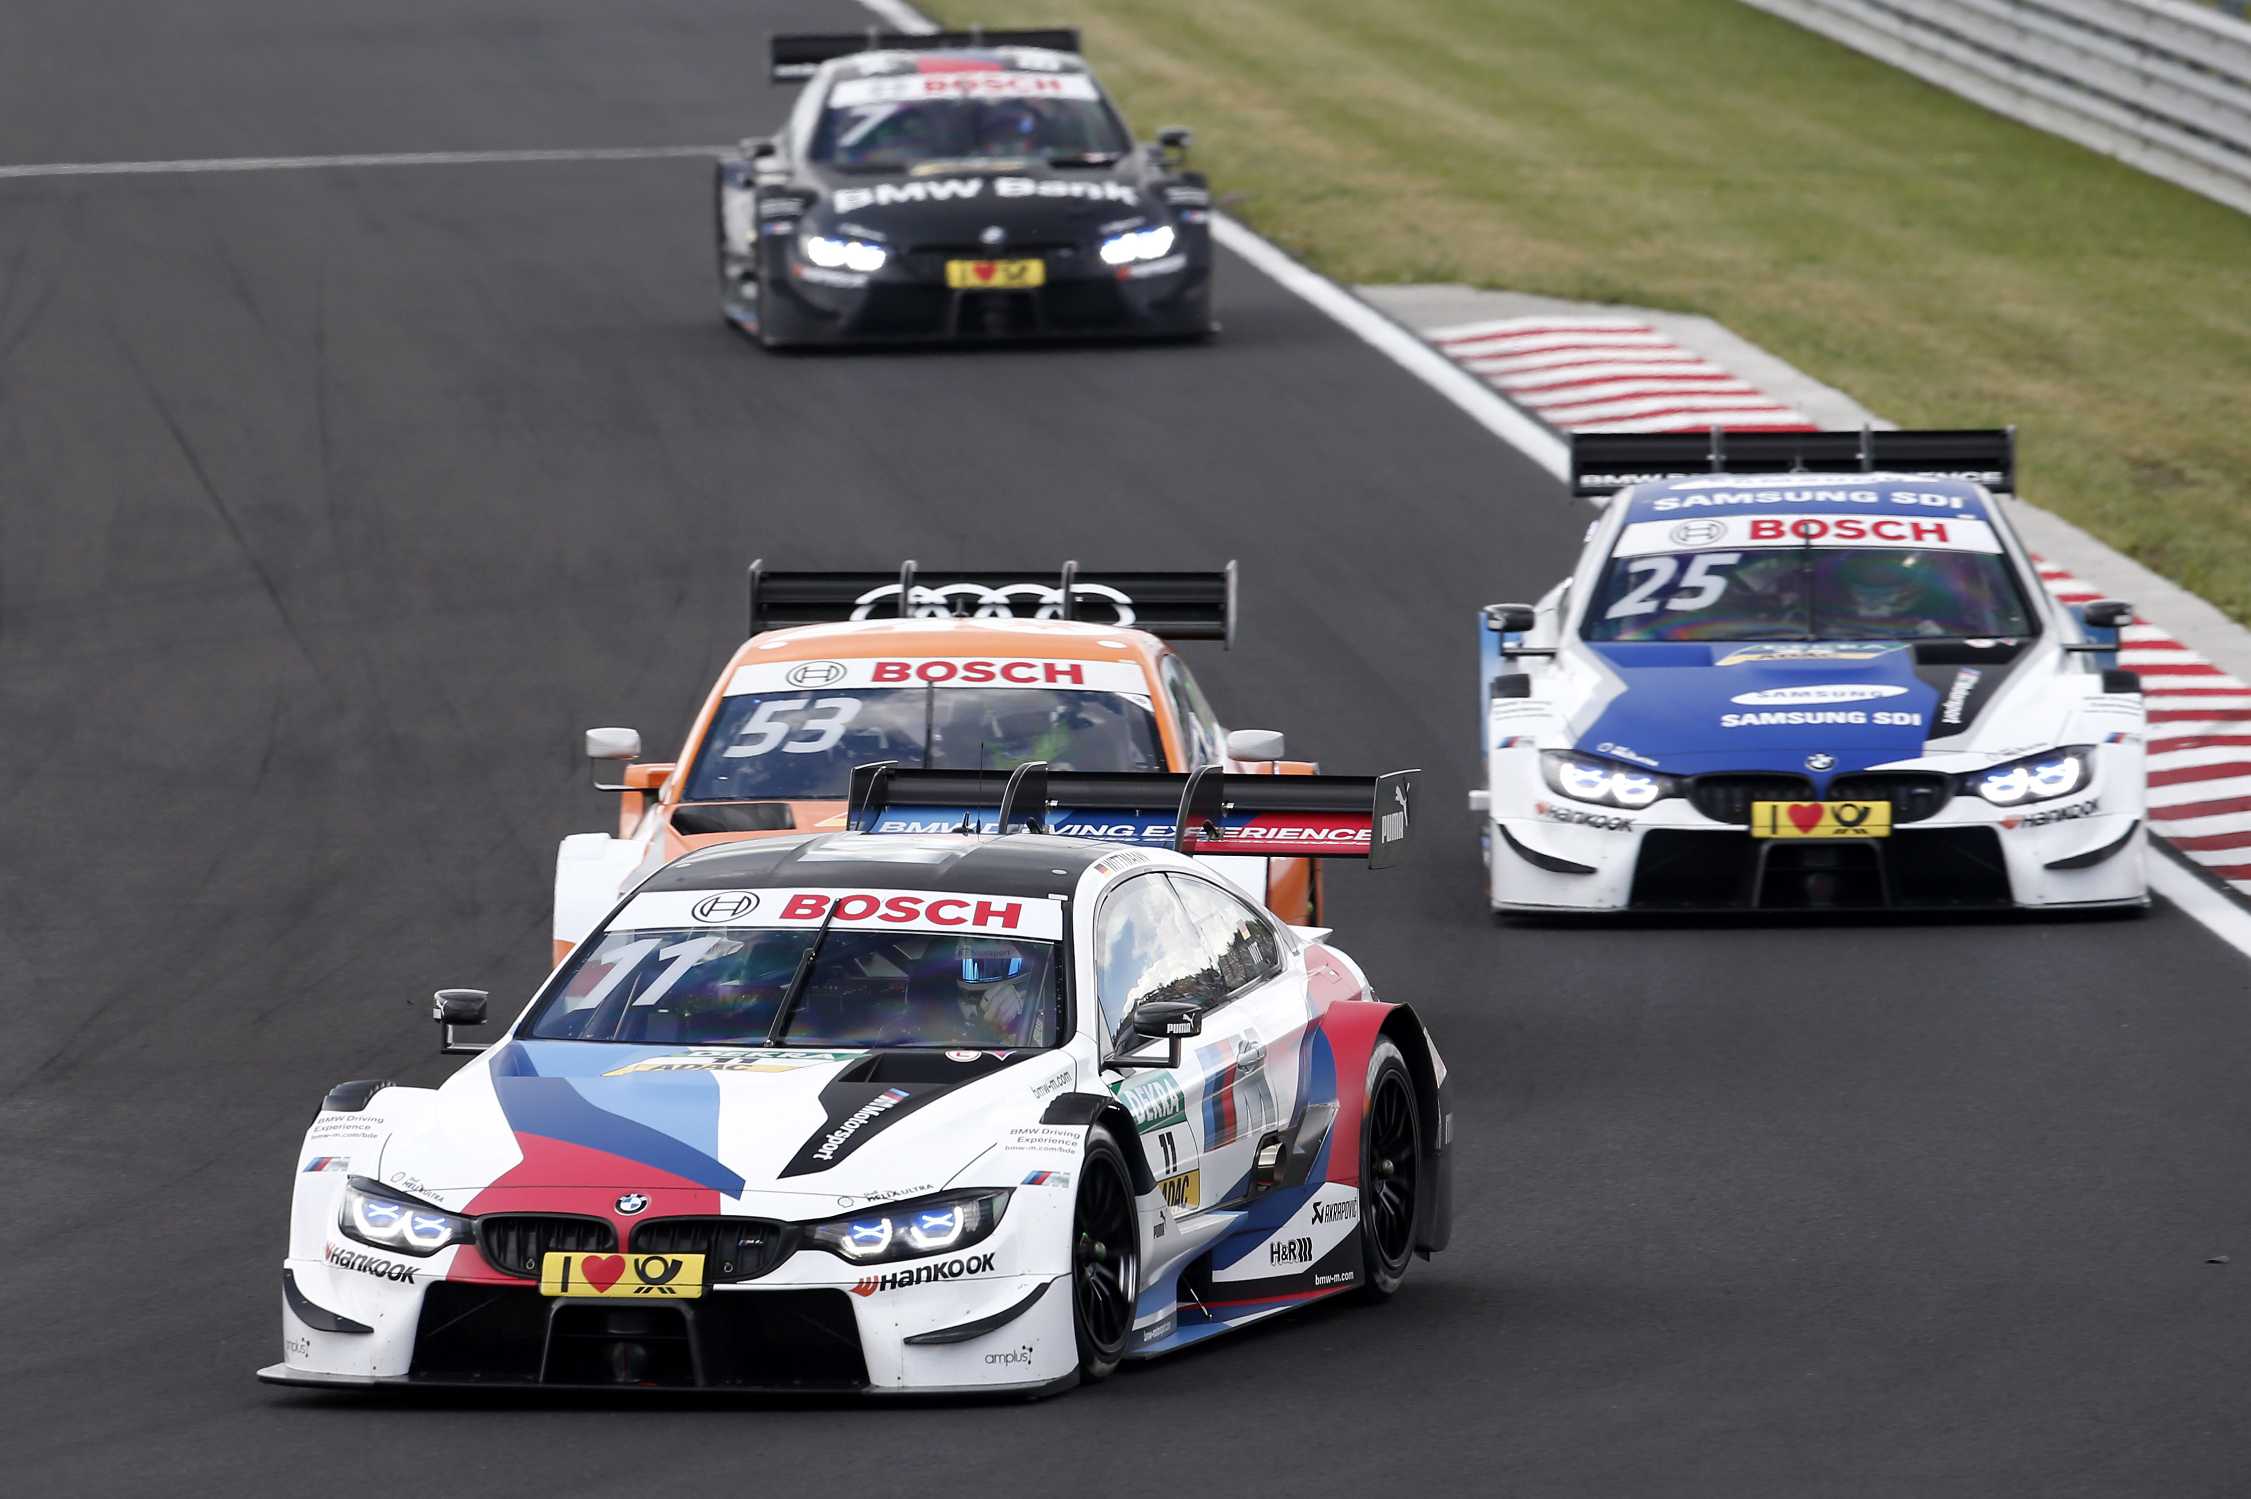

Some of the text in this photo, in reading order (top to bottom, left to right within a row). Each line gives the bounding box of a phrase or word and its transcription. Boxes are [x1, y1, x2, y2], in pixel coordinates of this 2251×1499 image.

[833, 178, 983, 214] BMW
[994, 176, 1138, 207] Bank
[1653, 490, 1963, 511] SAMSUNG SDI
[1748, 518, 1951, 543] BOSCH
[1604, 552, 1742, 620] 25
[872, 661, 1085, 685] BOSCH
[1757, 689, 1884, 698] SAMSUNG
[721, 697, 864, 759] 53
[1721, 711, 1922, 727] SAMSUNG SDI
[980, 823, 1135, 838] DVING
[1141, 825, 1372, 841] EERIENCE
[779, 893, 1024, 930] BOSCH
[567, 936, 723, 1011] 11
[1166, 1022, 1191, 1034] PUMA
[651, 1063, 753, 1072] ADAC
[1031, 1071, 1073, 1099] bmw-m.com
[313, 1123, 372, 1133] Experience
[316, 1115, 385, 1124] BMW Driving
[813, 1103, 881, 1160] Motorsport
[1017, 1136, 1078, 1146] Experience
[1041, 1128, 1081, 1140] Driving
[1158, 1131, 1178, 1175] 11
[1314, 1271, 1354, 1286] bmw-m.com
